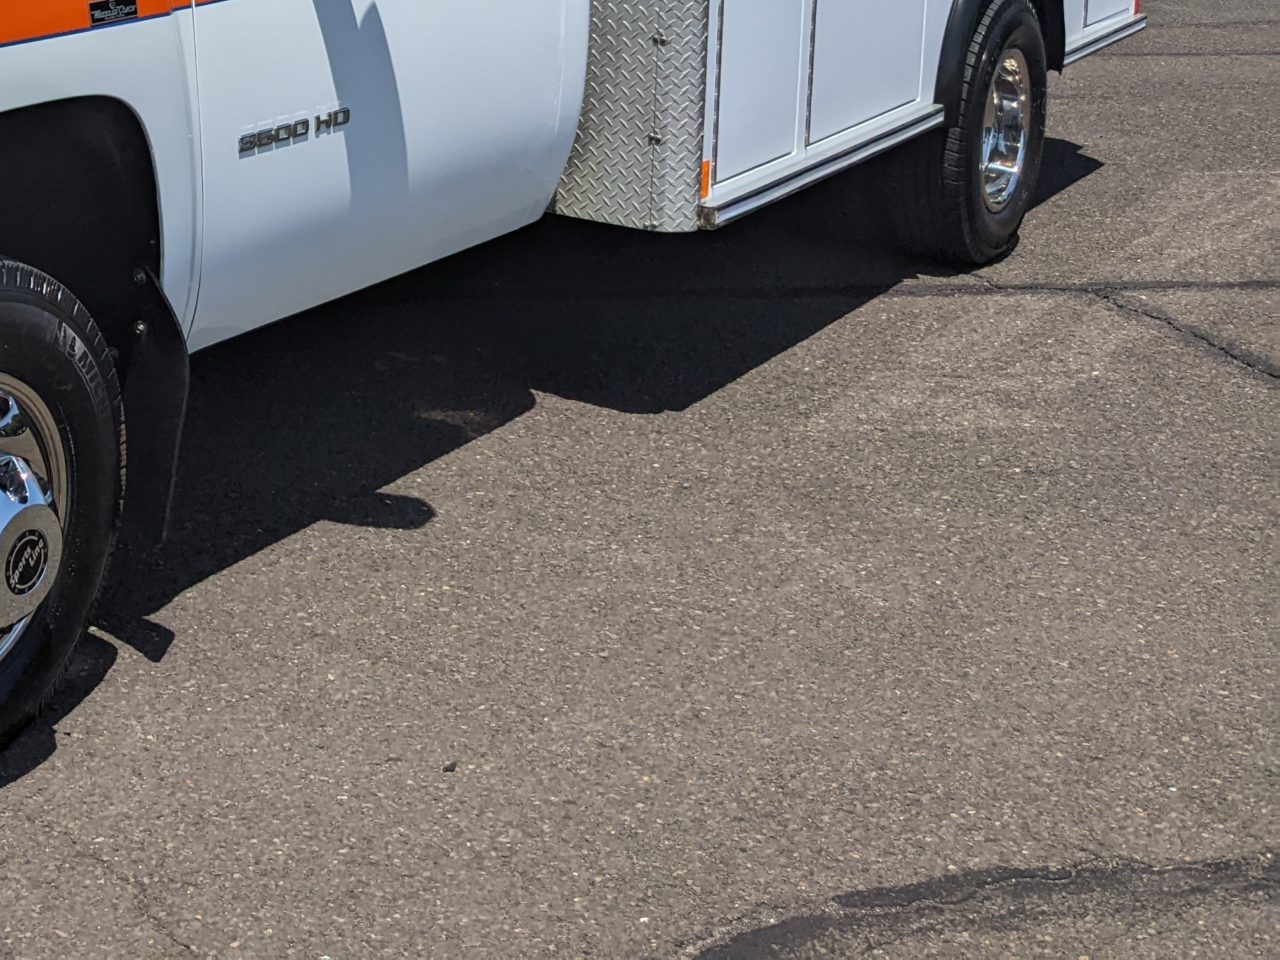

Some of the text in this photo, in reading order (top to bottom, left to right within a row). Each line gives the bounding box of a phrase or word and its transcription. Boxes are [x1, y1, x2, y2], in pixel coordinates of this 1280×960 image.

[238, 107, 351, 152] 3500 HD
[10, 538, 44, 588] Sports Line
